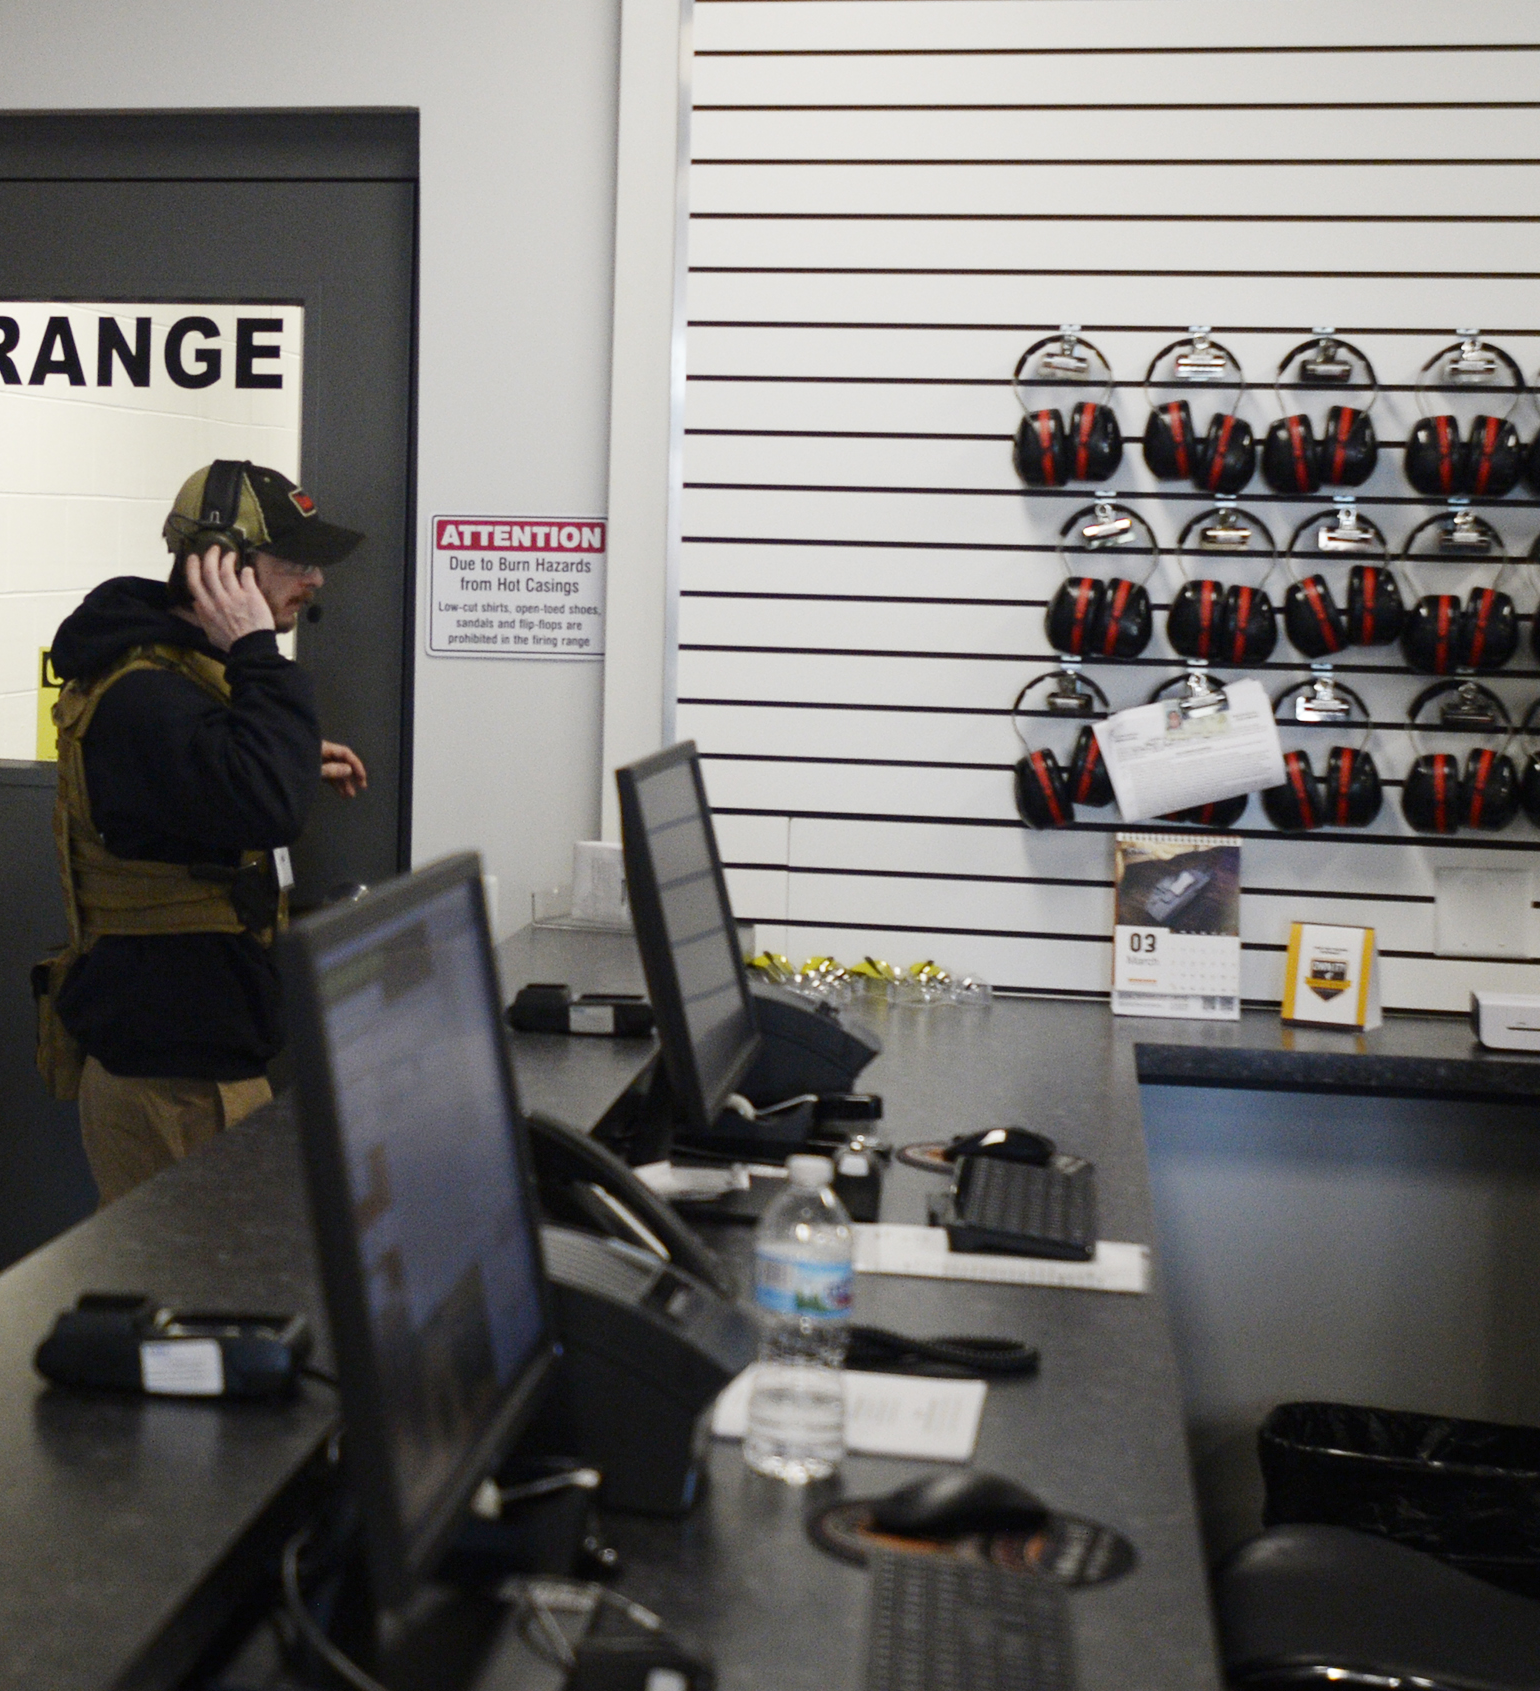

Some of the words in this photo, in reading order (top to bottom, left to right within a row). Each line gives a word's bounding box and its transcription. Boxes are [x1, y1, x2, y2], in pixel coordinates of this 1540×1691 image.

[440, 524, 602, 549] ATTENTION
[449, 556, 476, 571] Due
[481, 558, 493, 571] to
[498, 557, 530, 572] Burn
[535, 558, 592, 573] Hazards
[460, 577, 492, 592] from
[497, 577, 520, 592] Hot
[525, 577, 579, 596] Casings
[438, 601, 478, 613] Low-cut
[481, 602, 512, 615] shirts,
[515, 603, 565, 616] open-toed
[569, 604, 602, 616] shoes,
[456, 617, 494, 629] sandals
[497, 618, 516, 630] and
[519, 618, 563, 632] flip-flops
[566, 621, 582, 631] are
[448, 633, 498, 645] prohibited
[501, 635, 510, 645] in
[513, 634, 529, 645] the
[532, 635, 558, 648] firing
[561, 636, 590, 649] range
[1130, 933, 1156, 953] 03
